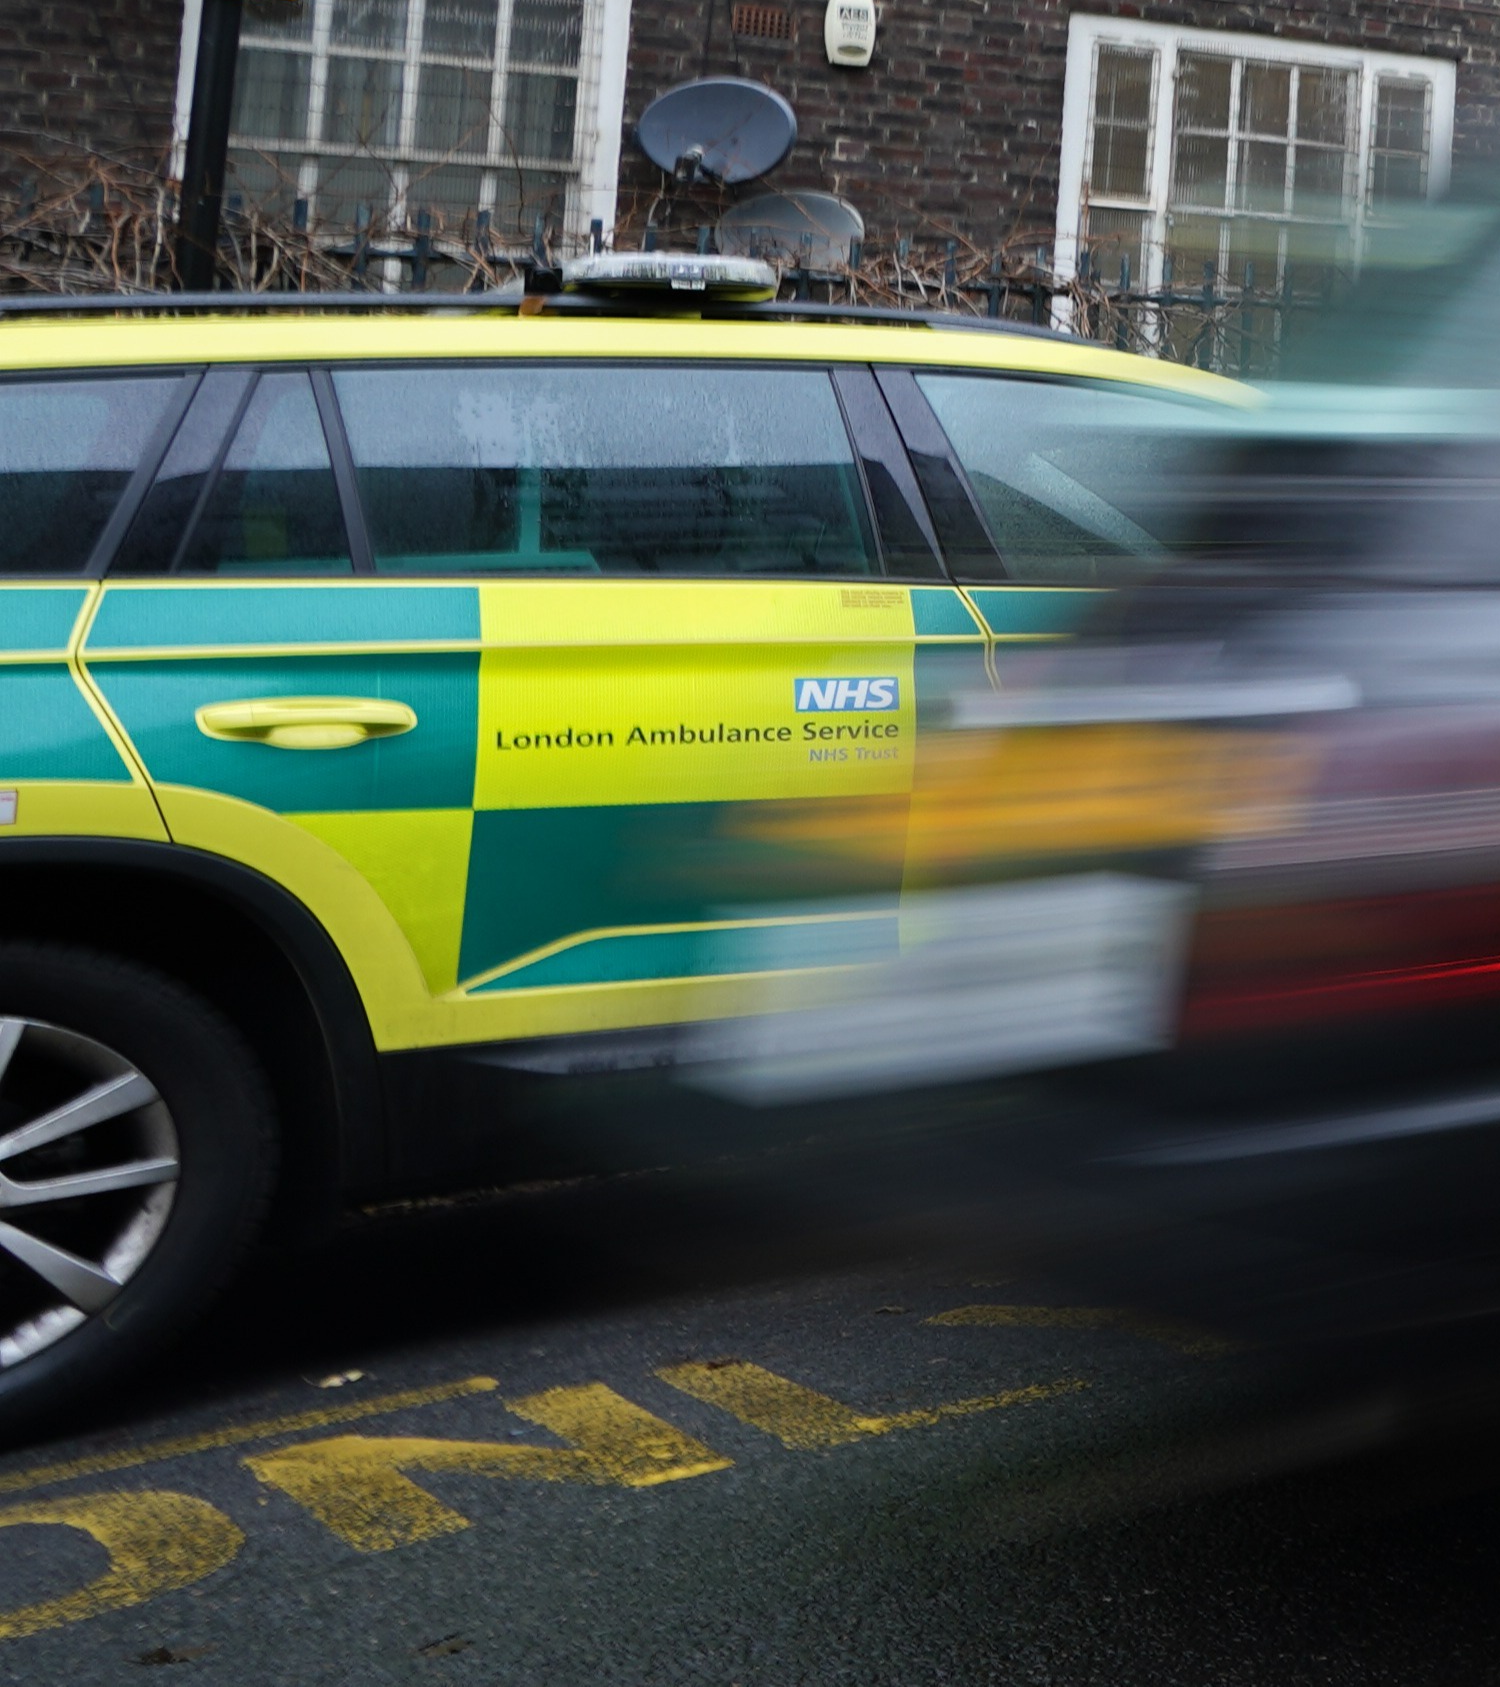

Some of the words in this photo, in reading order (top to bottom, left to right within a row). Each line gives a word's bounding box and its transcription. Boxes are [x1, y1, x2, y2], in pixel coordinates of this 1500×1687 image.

[798, 679, 895, 710] NHS
[497, 727, 614, 750] London
[627, 723, 791, 745] Ambulance
[803, 720, 899, 740] Service
[810, 748, 848, 762] NHS
[855, 746, 900, 760] Trust
